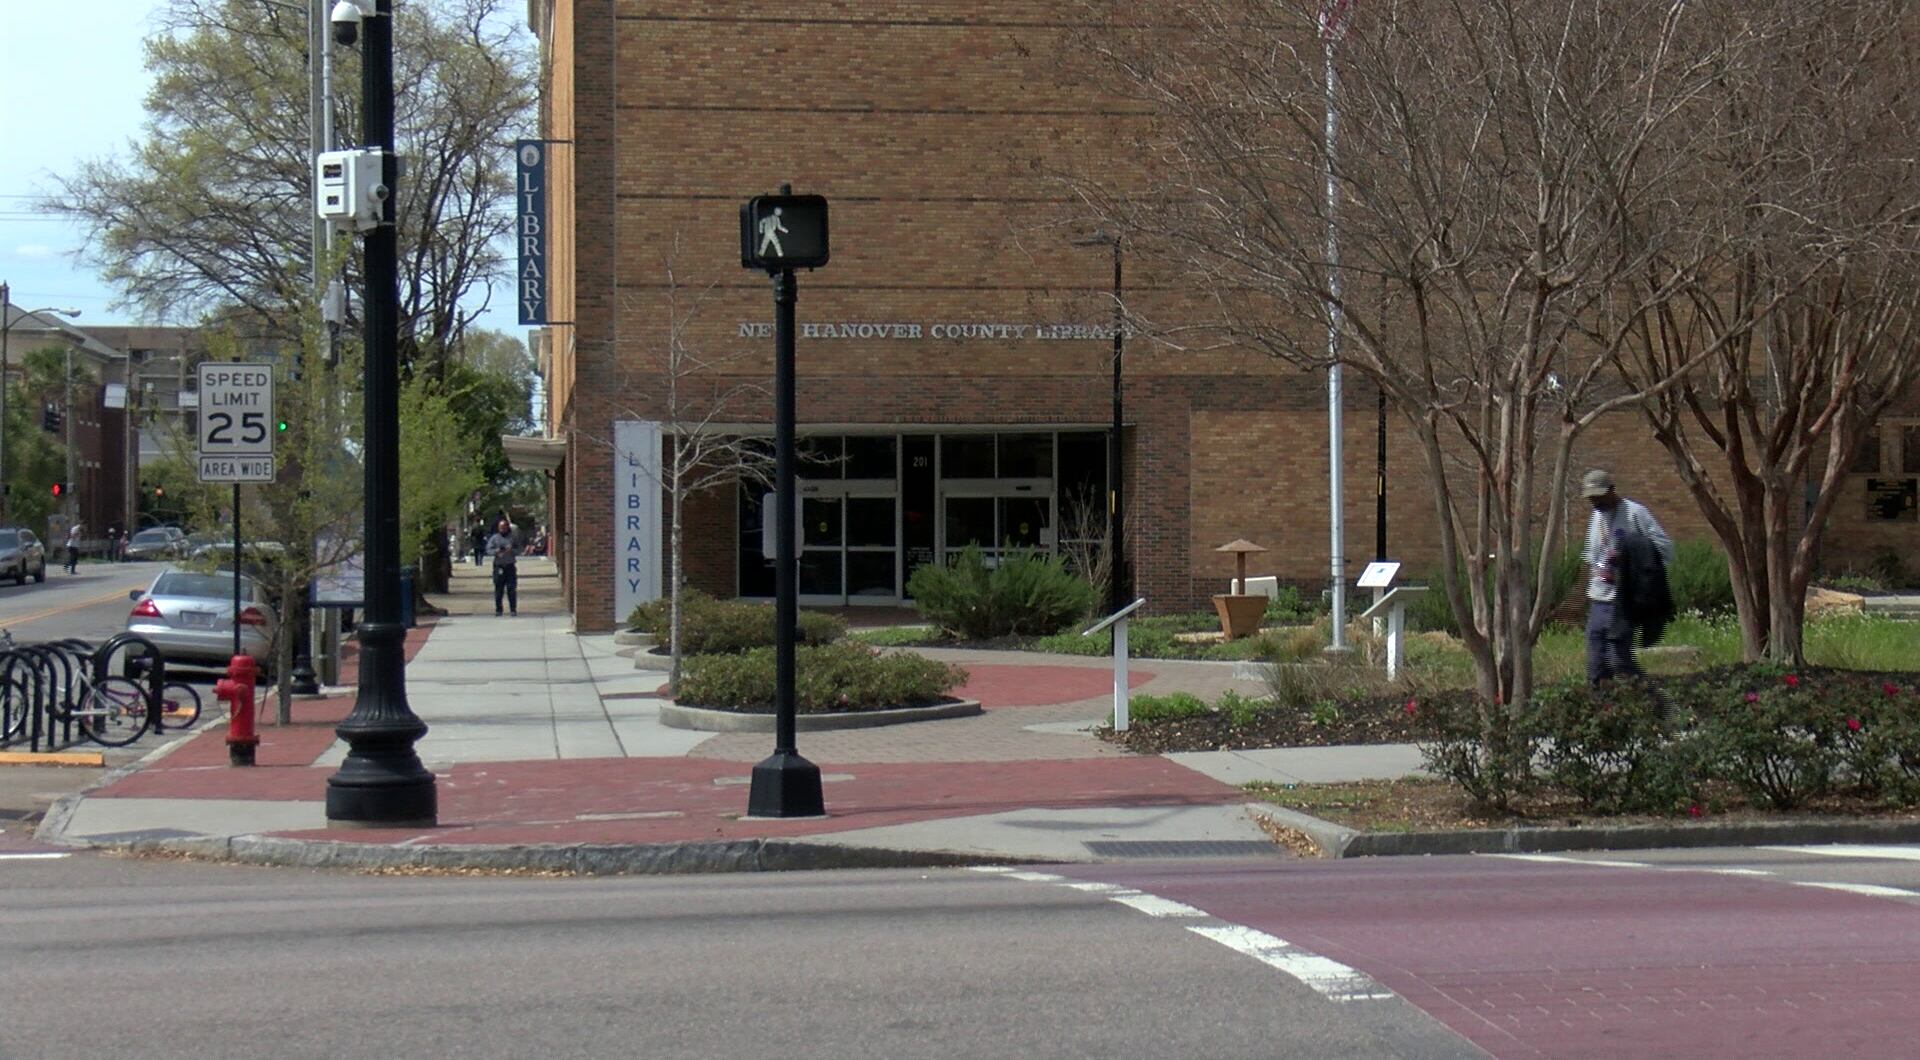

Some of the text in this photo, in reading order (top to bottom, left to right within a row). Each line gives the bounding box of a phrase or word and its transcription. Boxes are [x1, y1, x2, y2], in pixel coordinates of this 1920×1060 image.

[522, 172, 543, 321] LIBRARY
[738, 322, 777, 338] NE
[801, 322, 923, 338] HANOVER
[931, 322, 1032, 339] COUNTY
[205, 372, 268, 387] SPEED
[212, 392, 261, 406] LIMIT
[207, 412, 267, 444] 25
[204, 462, 271, 476] AREA WIDE
[912, 456, 928, 468] 201
[627, 452, 641, 594] LIBRARY
